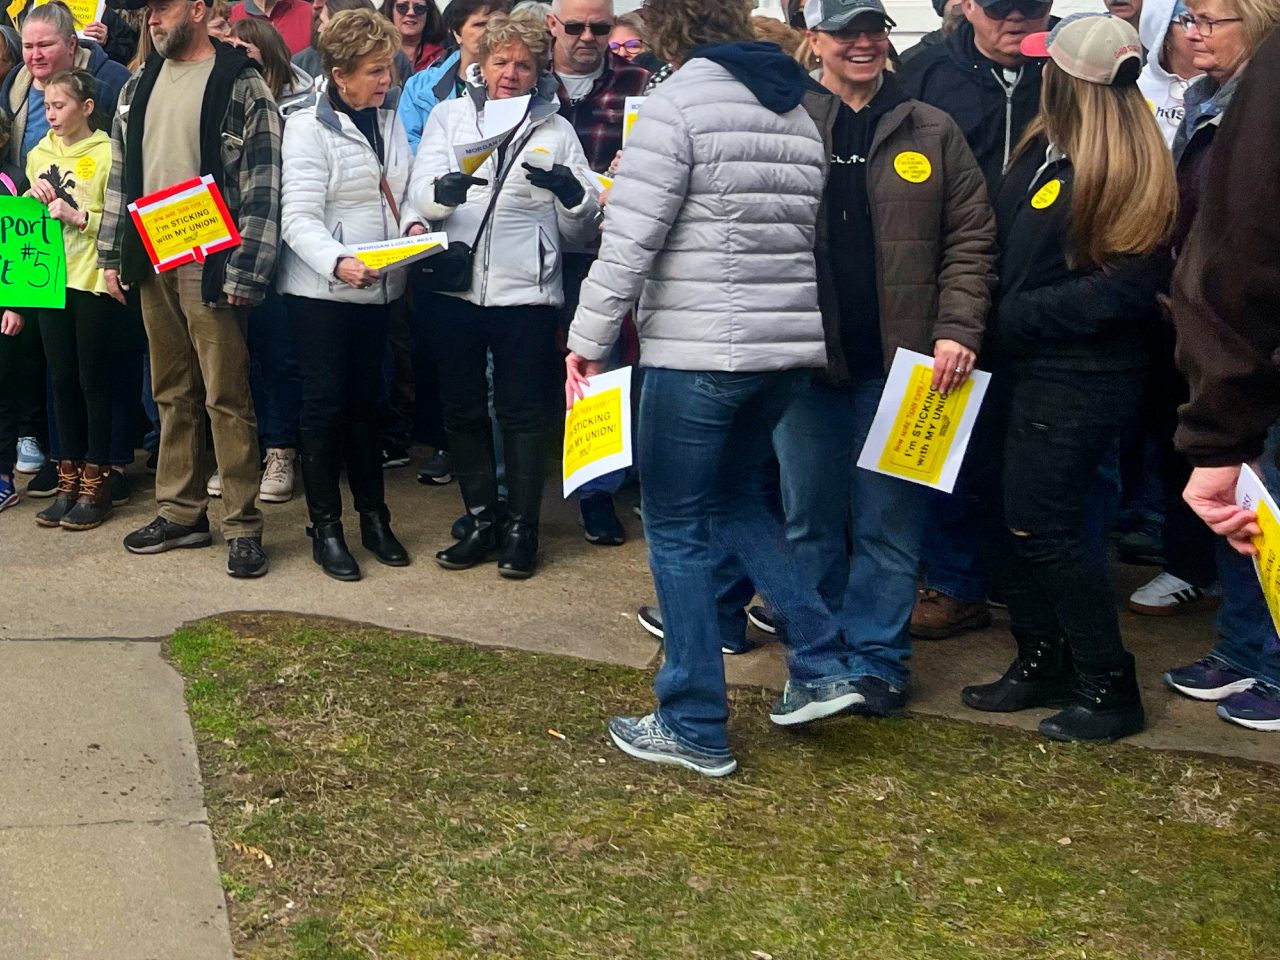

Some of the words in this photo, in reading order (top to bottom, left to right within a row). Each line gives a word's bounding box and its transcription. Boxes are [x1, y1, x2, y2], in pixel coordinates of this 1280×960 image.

[466, 140, 498, 154] MORGAN
[156, 224, 170, 232] I'm
[170, 208, 210, 228] STICKING
[156, 232, 174, 244] with
[174, 227, 188, 237] MY
[190, 216, 218, 232] UNION!
[21, 242, 60, 293] #51
[574, 412, 611, 434] STICKING
[917, 444, 930, 466] with
[924, 424, 936, 440] MY
[932, 392, 948, 420] UNIO
[574, 436, 584, 447] MY
[586, 424, 616, 442] UNION!
[904, 440, 918, 458] I'm
